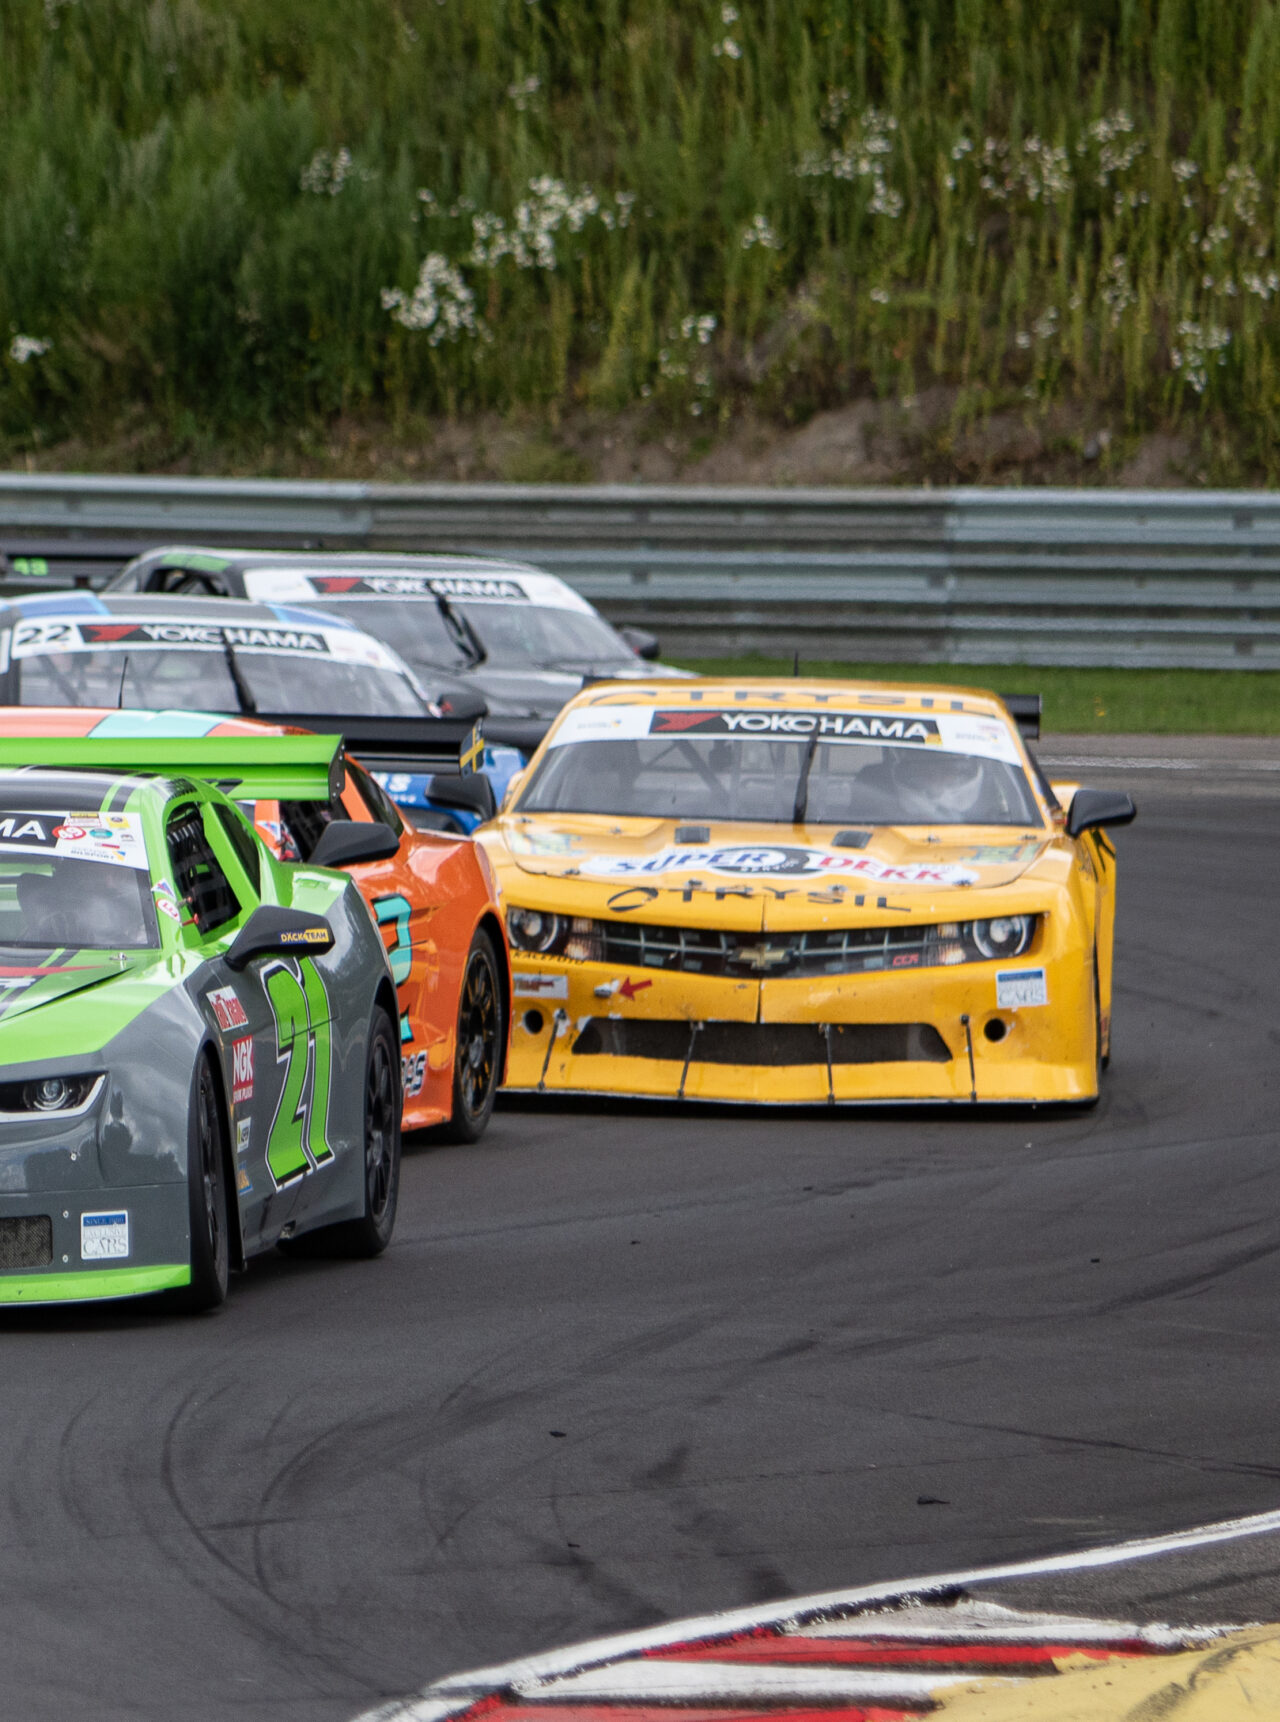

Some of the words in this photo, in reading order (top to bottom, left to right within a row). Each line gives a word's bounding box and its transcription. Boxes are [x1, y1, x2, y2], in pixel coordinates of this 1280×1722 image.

[17, 625, 72, 646] 22
[140, 624, 326, 650] YOKOHAMA
[721, 711, 930, 739] YOKOHAMA
[617, 850, 771, 874] SUPER
[816, 855, 952, 881] DEKK
[232, 1037, 254, 1087] NGK
[260, 955, 336, 1194] 21
[82, 1237, 127, 1256] CARS
